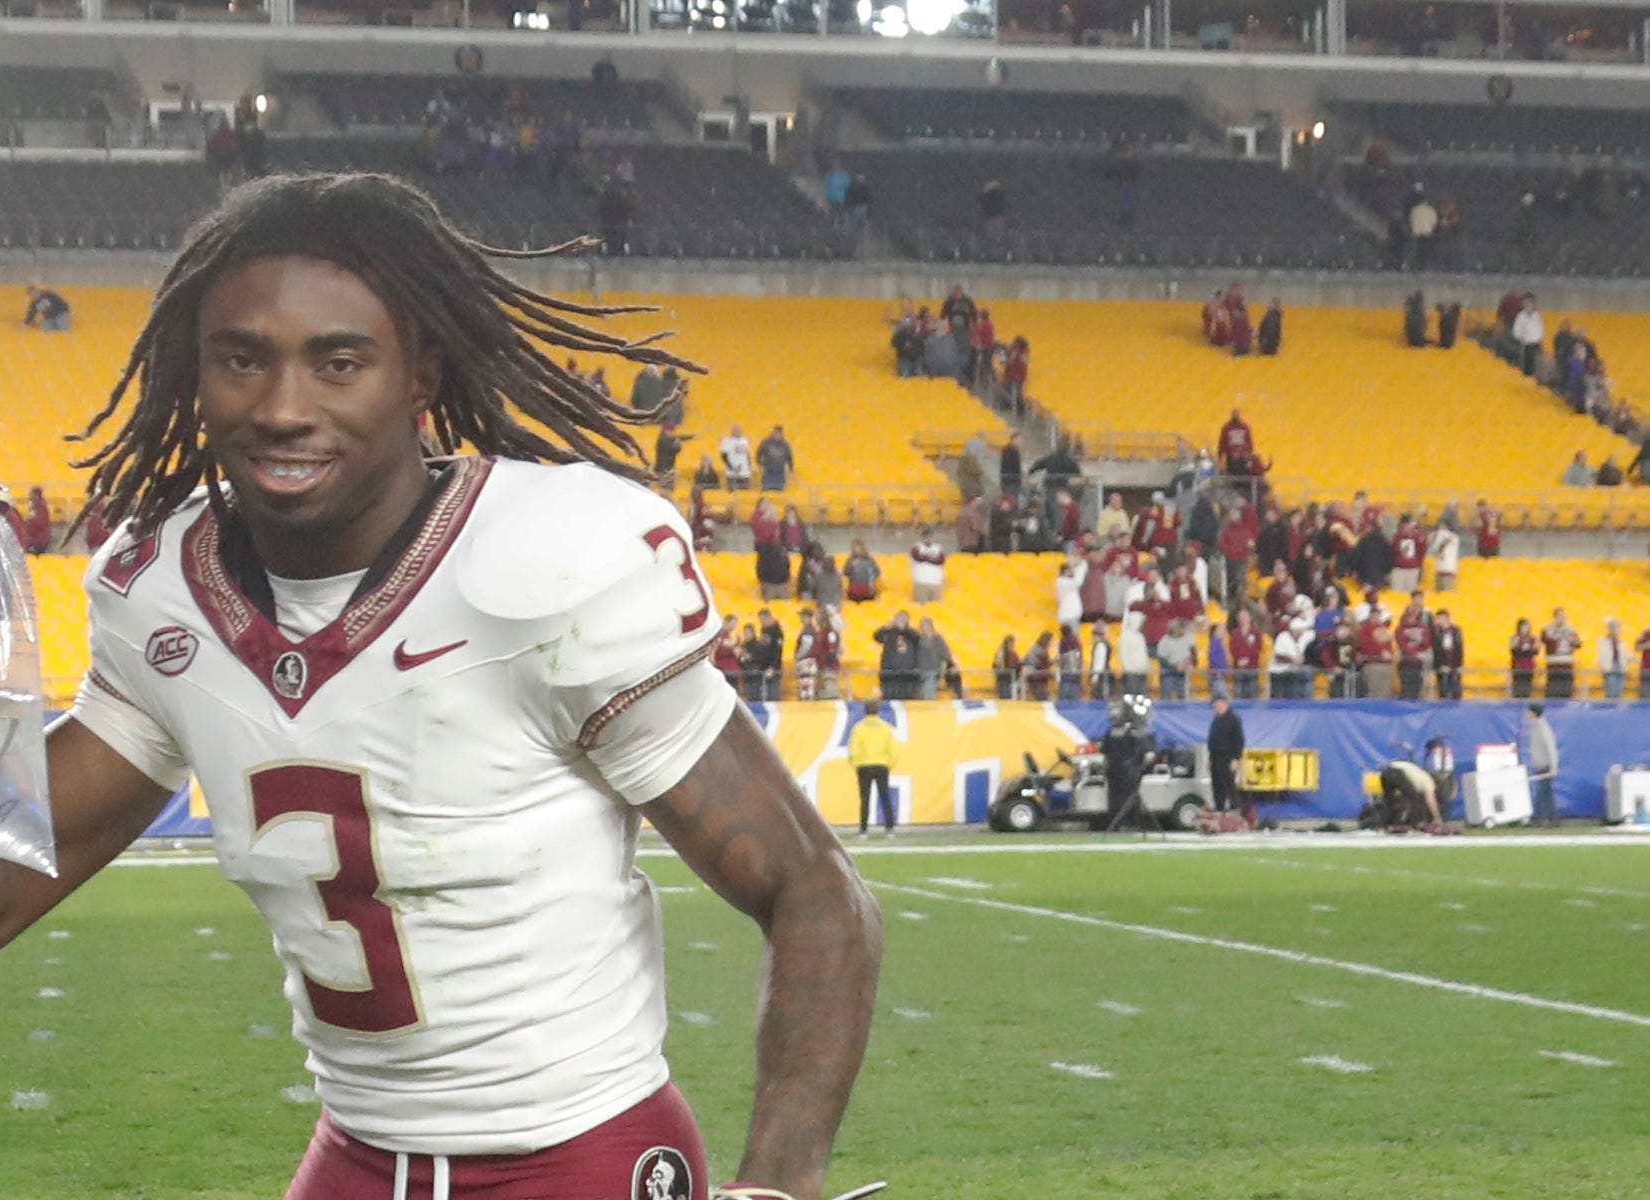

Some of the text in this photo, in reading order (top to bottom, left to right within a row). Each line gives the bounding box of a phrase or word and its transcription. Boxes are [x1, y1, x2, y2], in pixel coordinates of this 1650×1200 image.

[639, 522, 710, 638] 3
[153, 635, 189, 660] ACC
[243, 758, 428, 1039] 3
